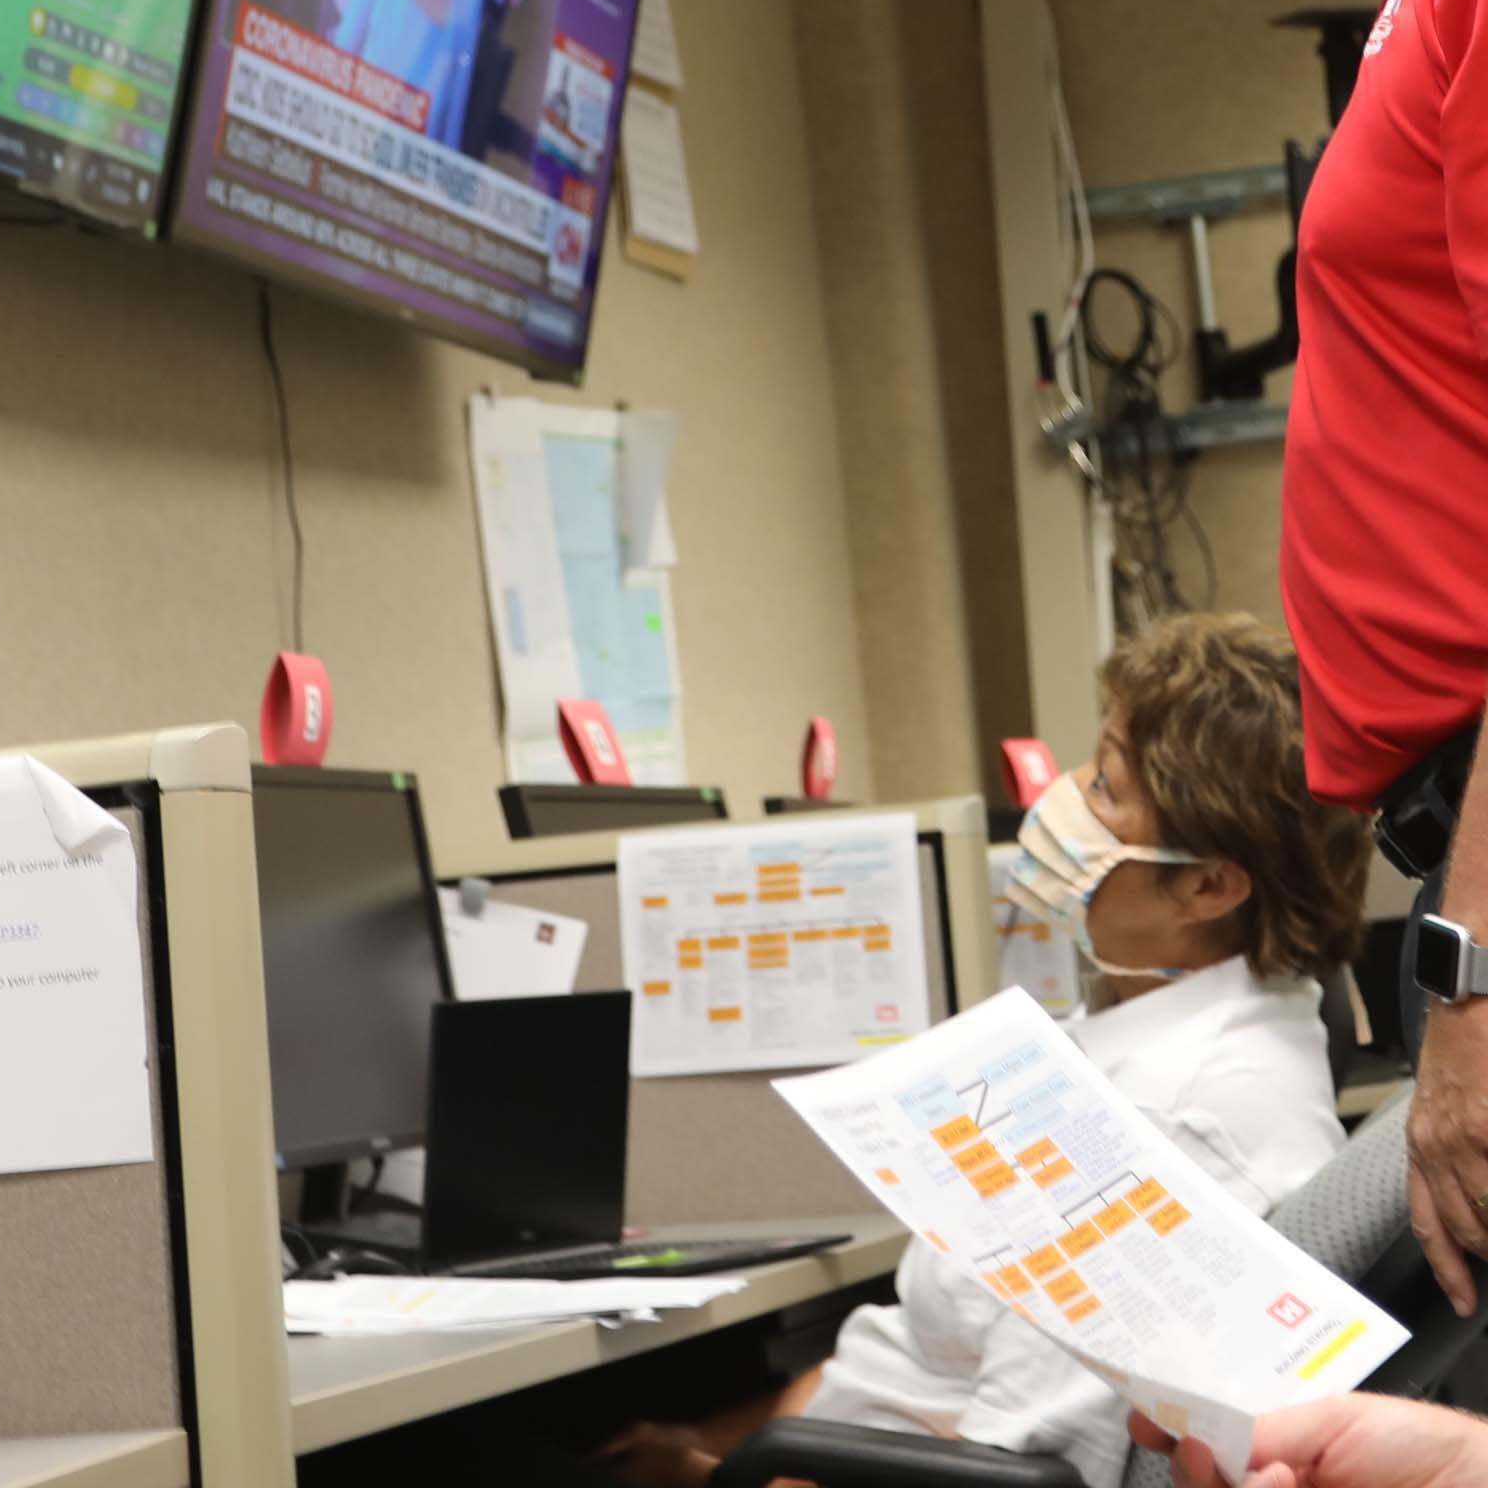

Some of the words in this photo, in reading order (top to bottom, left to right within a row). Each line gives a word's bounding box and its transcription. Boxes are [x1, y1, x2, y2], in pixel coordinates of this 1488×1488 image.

[240, 3, 355, 92] CORONAVIRUS
[18, 856, 59, 874] corner
[81, 849, 104, 867] the
[7, 971, 34, 991] your
[37, 964, 99, 988] computer
